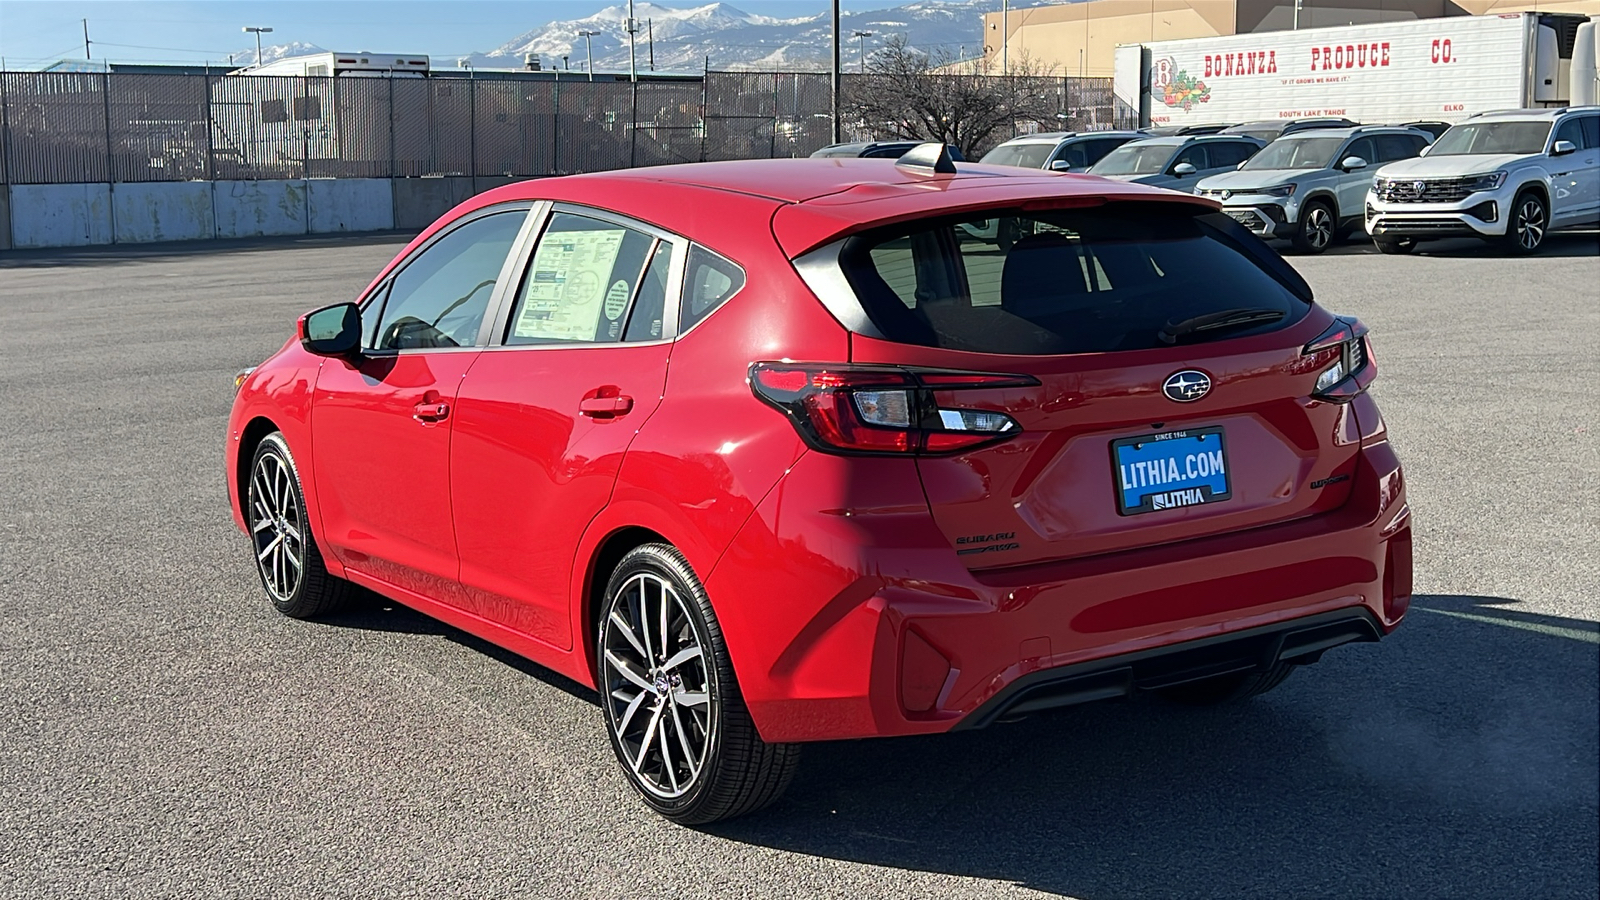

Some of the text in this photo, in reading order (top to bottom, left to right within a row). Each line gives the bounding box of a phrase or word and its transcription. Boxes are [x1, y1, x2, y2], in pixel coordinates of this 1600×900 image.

[1204, 39, 1457, 77] BONANZA PRODUCE CO.
[1155, 432, 1173, 441] SINCE
[1120, 450, 1225, 490] LITHIA.COM
[1164, 488, 1204, 508] LITHIA
[957, 532, 1016, 544] SUBARU
